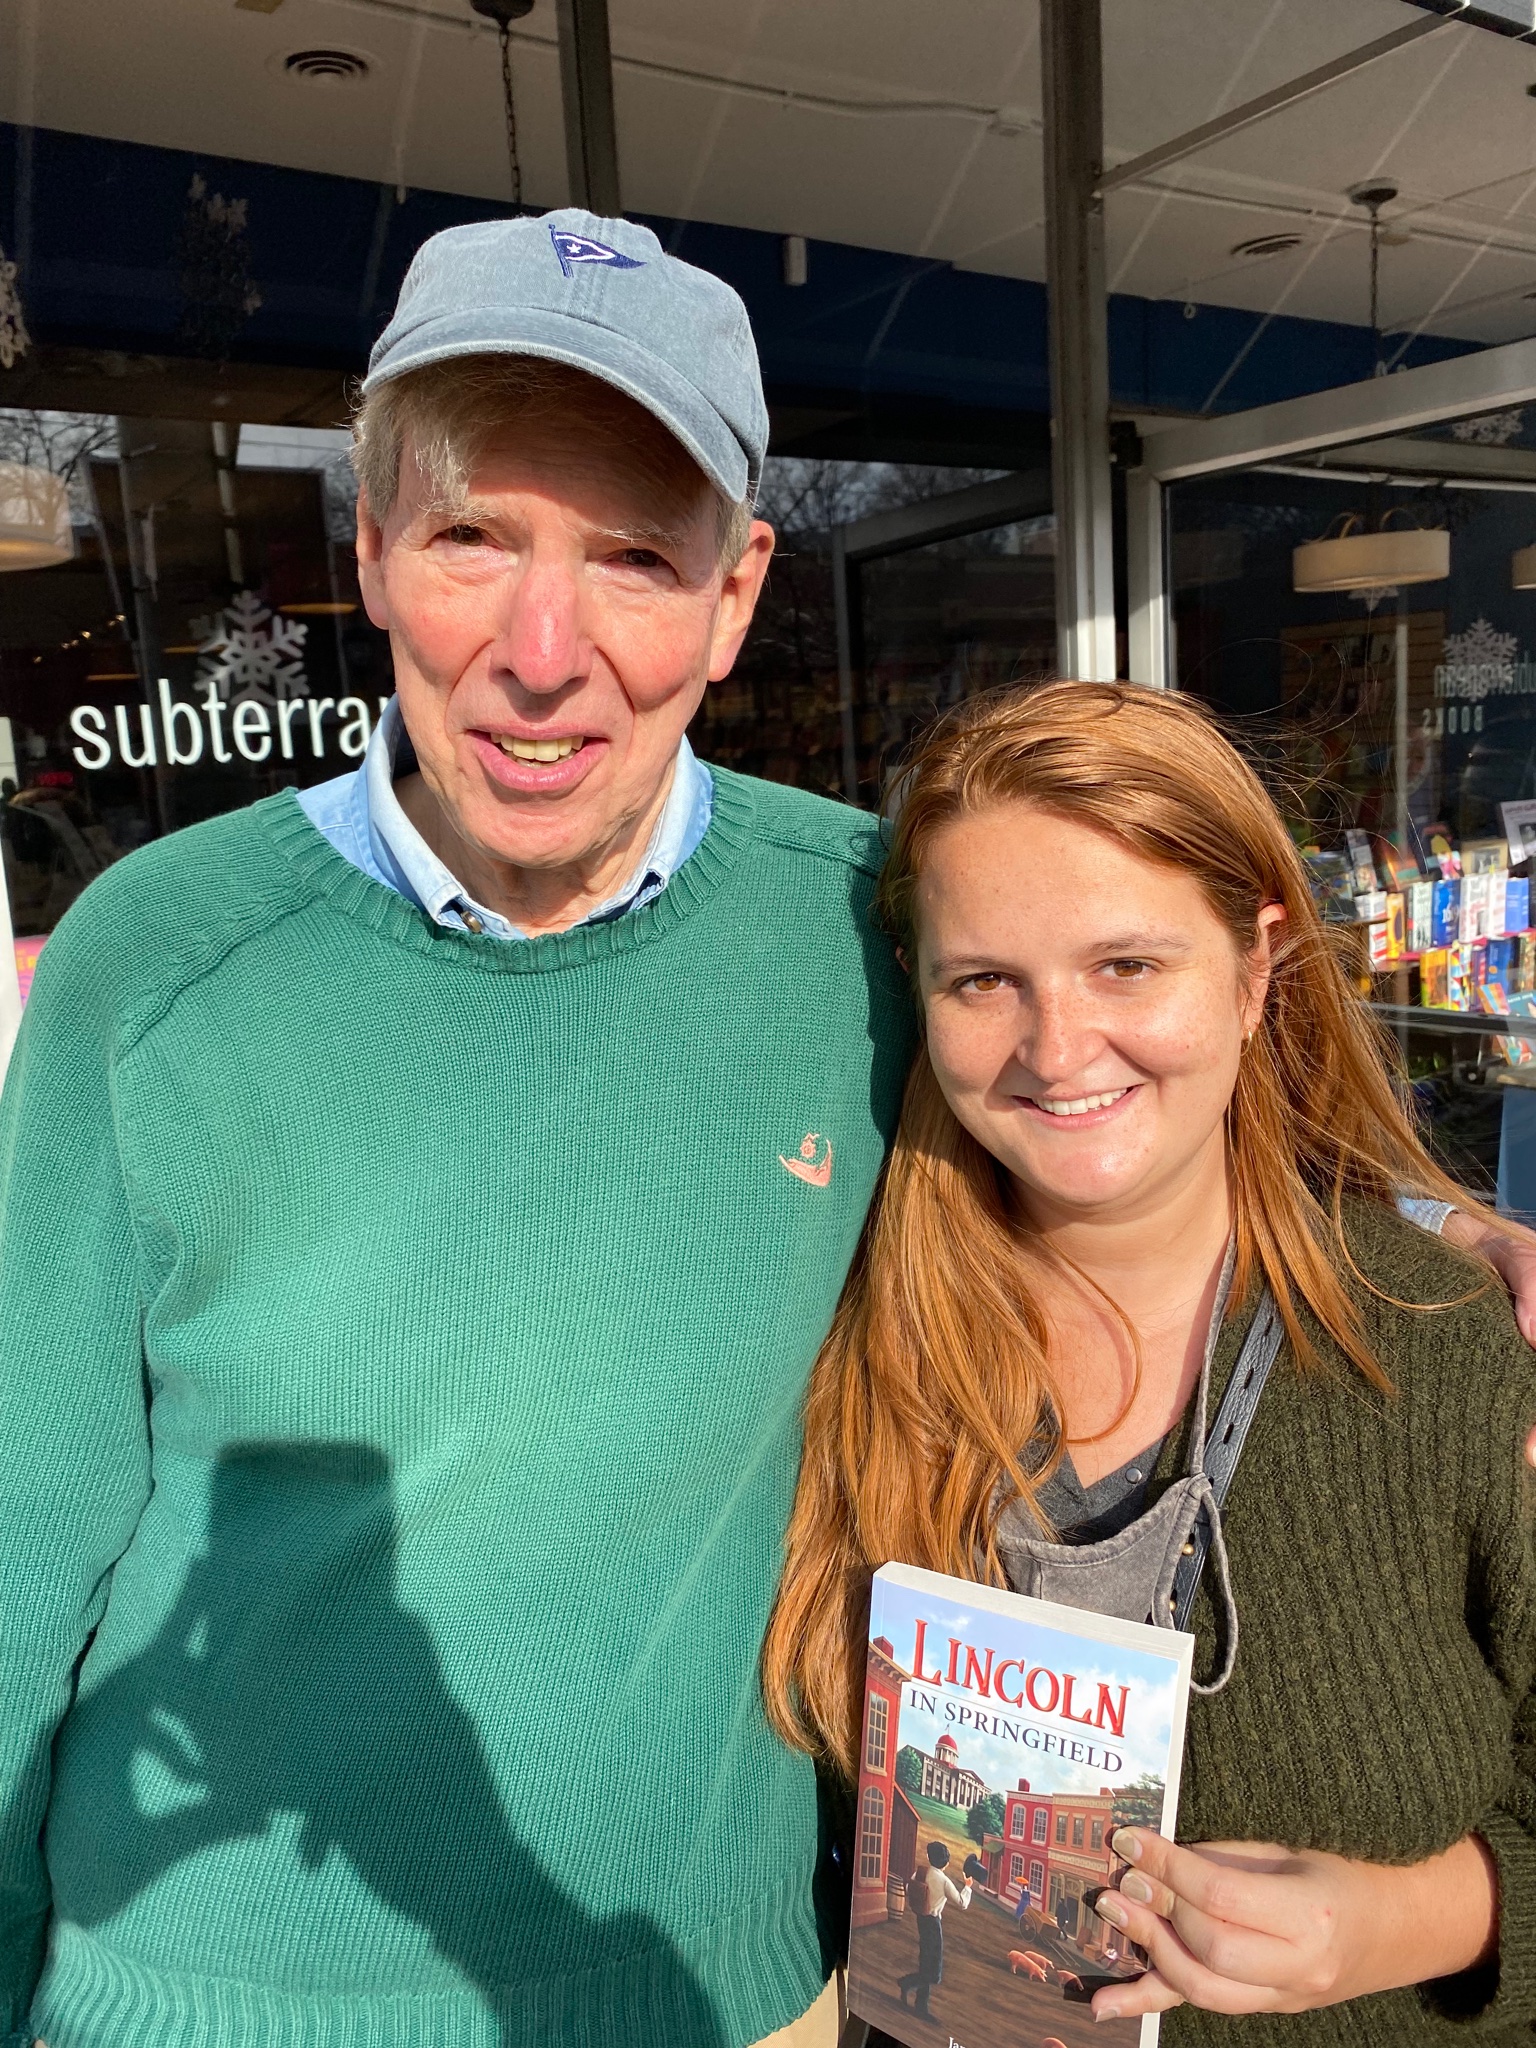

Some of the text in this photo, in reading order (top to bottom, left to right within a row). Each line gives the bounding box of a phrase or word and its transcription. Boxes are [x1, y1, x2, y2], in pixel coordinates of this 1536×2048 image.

[911, 1618, 1131, 1738] LINCOLN
[910, 1688, 1123, 1773] IN SPRINGFIELD
